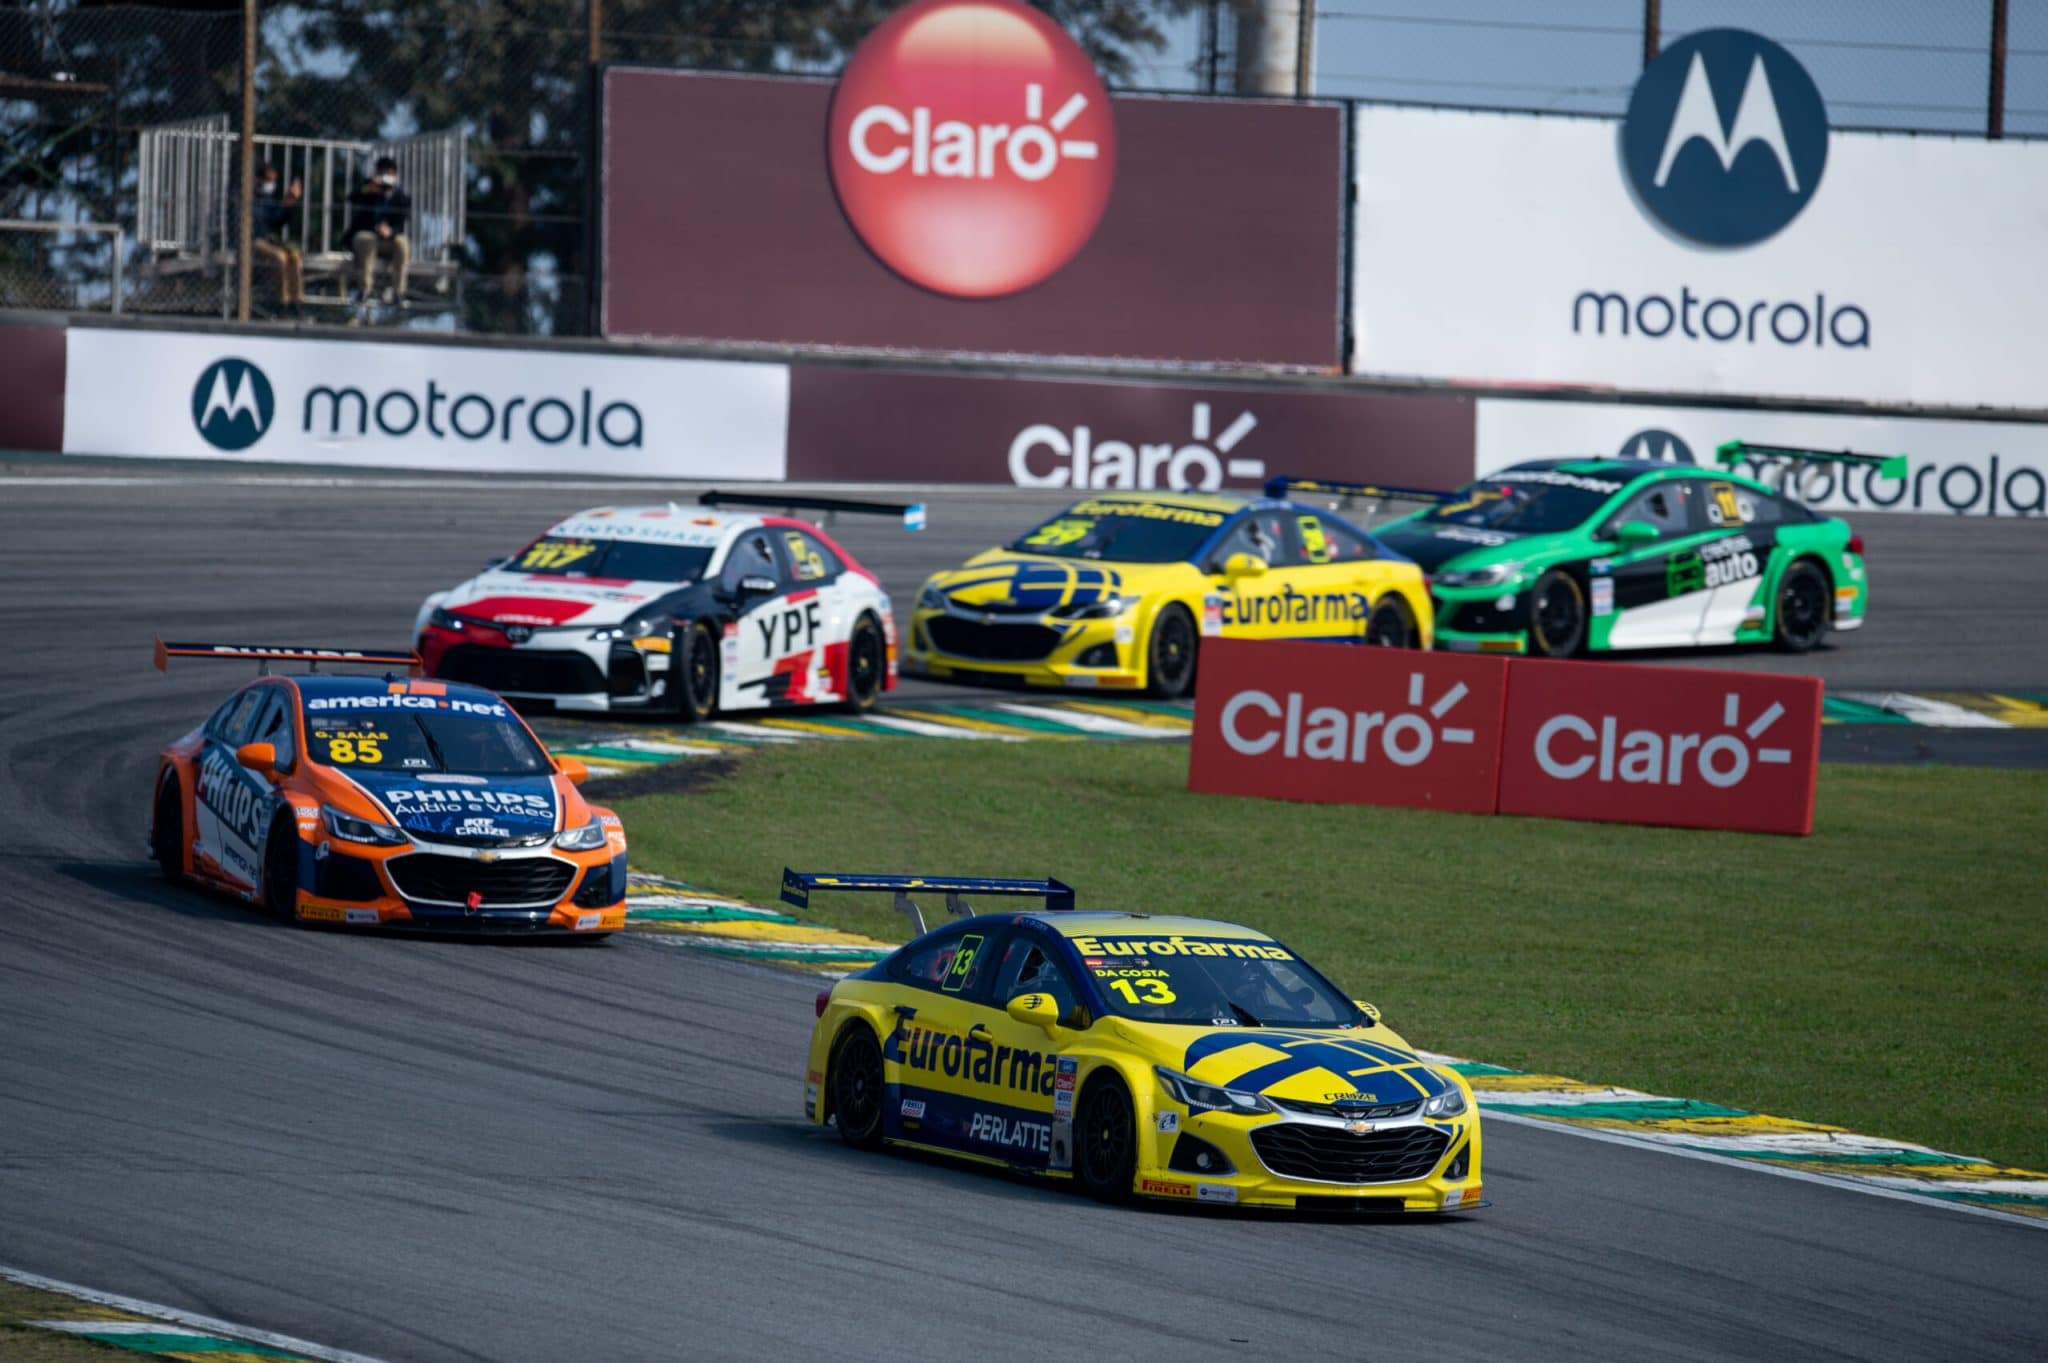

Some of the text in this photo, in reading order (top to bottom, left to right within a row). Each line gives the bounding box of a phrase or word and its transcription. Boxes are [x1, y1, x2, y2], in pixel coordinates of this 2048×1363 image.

[849, 105, 1058, 180] Claro
[1572, 286, 1870, 348] motorola
[303, 380, 644, 449] motorola
[1008, 425, 1223, 490] Claro
[557, 524, 636, 537] KINTO
[1070, 501, 1223, 527] Eurofarma
[1705, 552, 1758, 588] auto
[1216, 583, 1370, 625] Eurofarma
[757, 600, 823, 660] YPF
[336, 731, 390, 741] SALAS
[1220, 689, 1434, 767] Claro
[328, 739, 383, 764] 85
[1534, 713, 1750, 788] Claro
[199, 749, 263, 846] PHILIPS
[385, 789, 550, 809] PHILIPS
[394, 802, 554, 819] Audio e Video
[455, 826, 510, 838] CRUZE
[950, 948, 975, 977] 13
[1071, 935, 1295, 961] Eurofarma
[1095, 969, 1170, 978] DA COSTA
[1109, 977, 1177, 1005] 13
[884, 1005, 1058, 1097] Eurofarma
[969, 1111, 1051, 1153] PERLATTE
